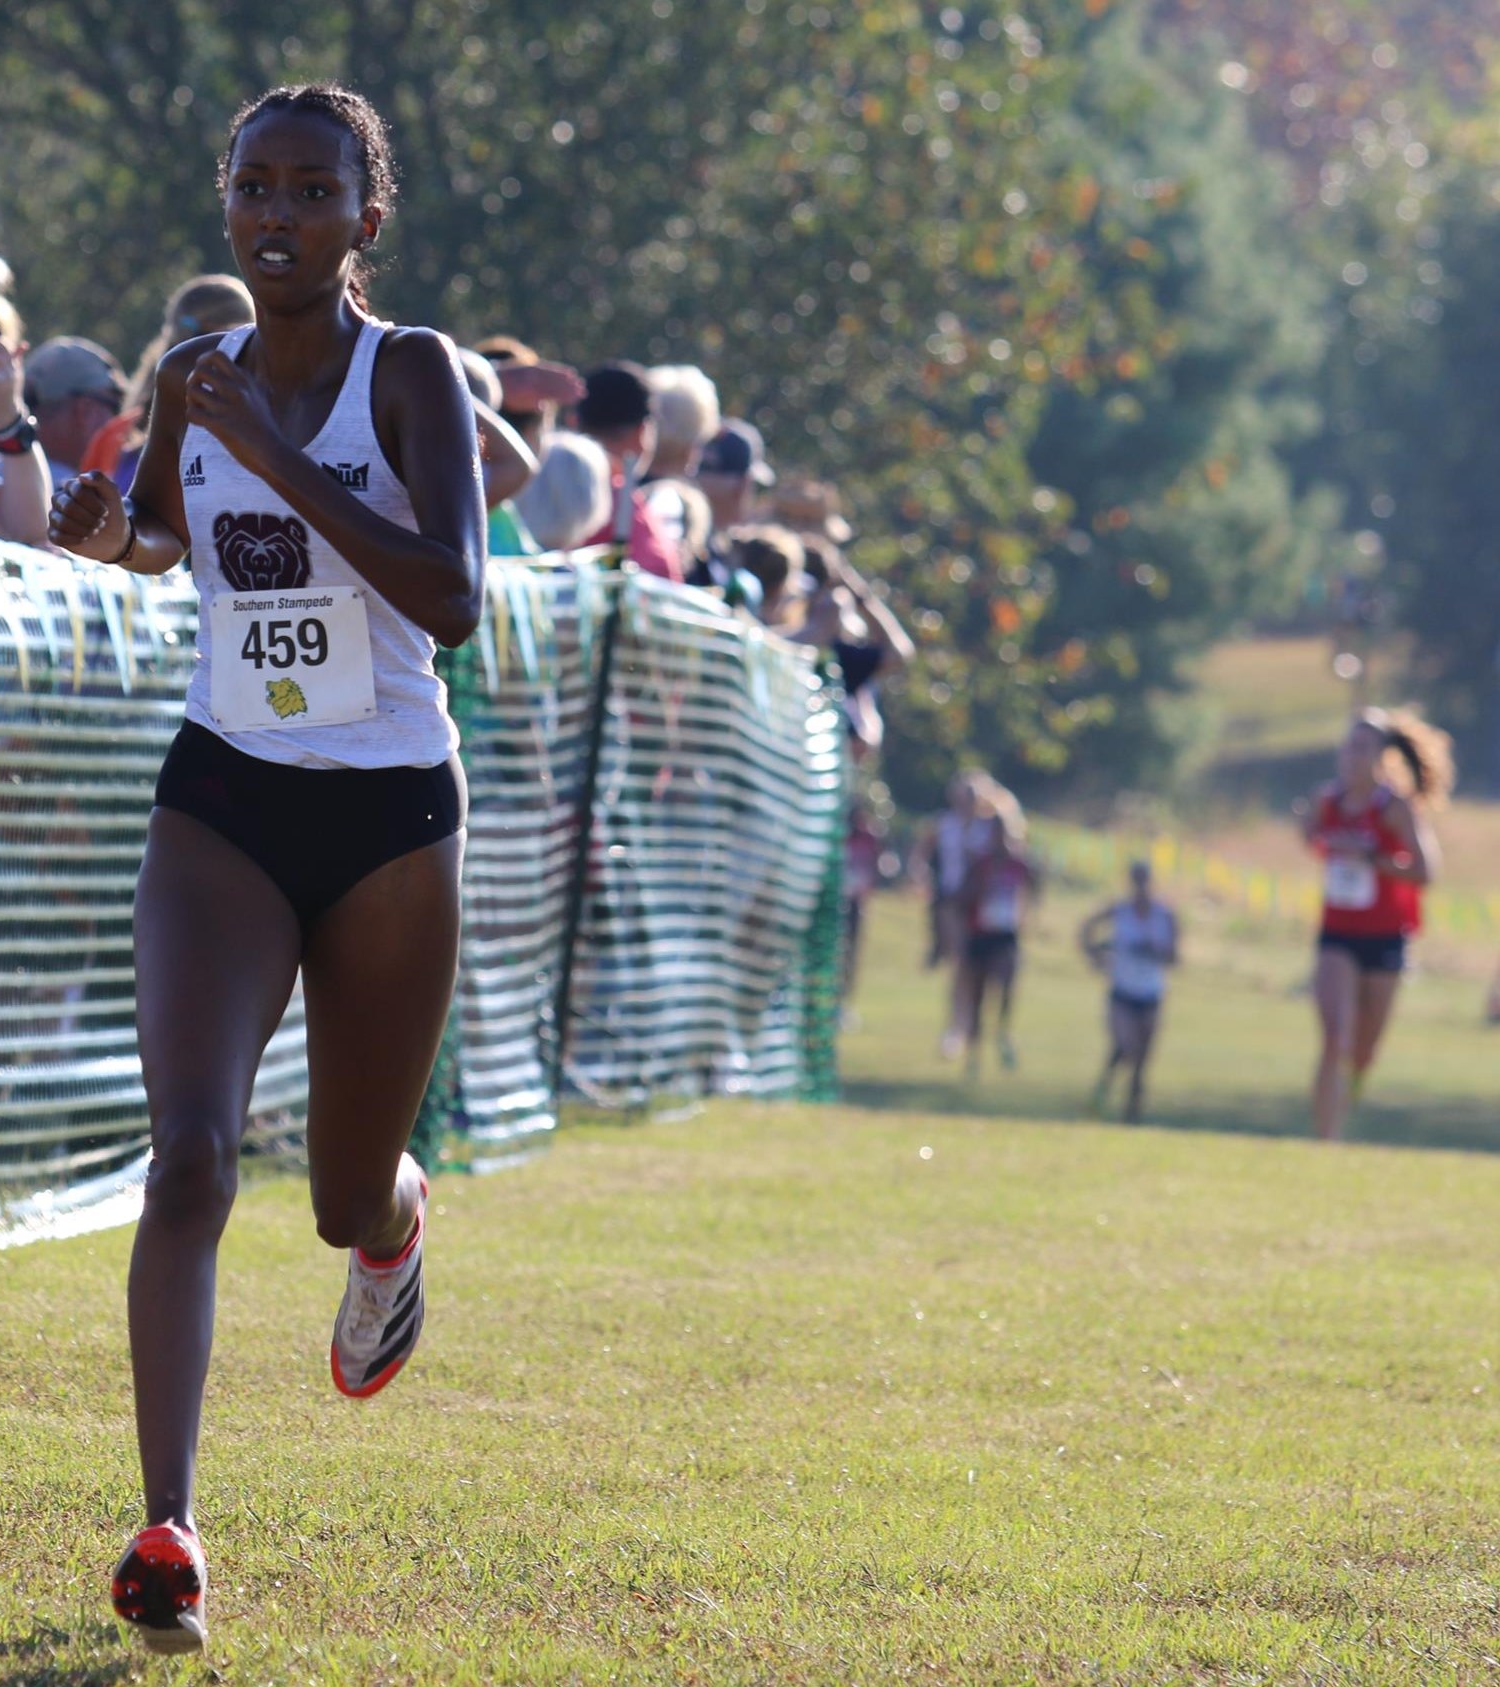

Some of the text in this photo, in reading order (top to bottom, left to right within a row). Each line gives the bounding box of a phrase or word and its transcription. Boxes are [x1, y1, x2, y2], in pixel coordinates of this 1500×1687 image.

[233, 595, 333, 612] Southern Stampede
[241, 617, 328, 669] 459
